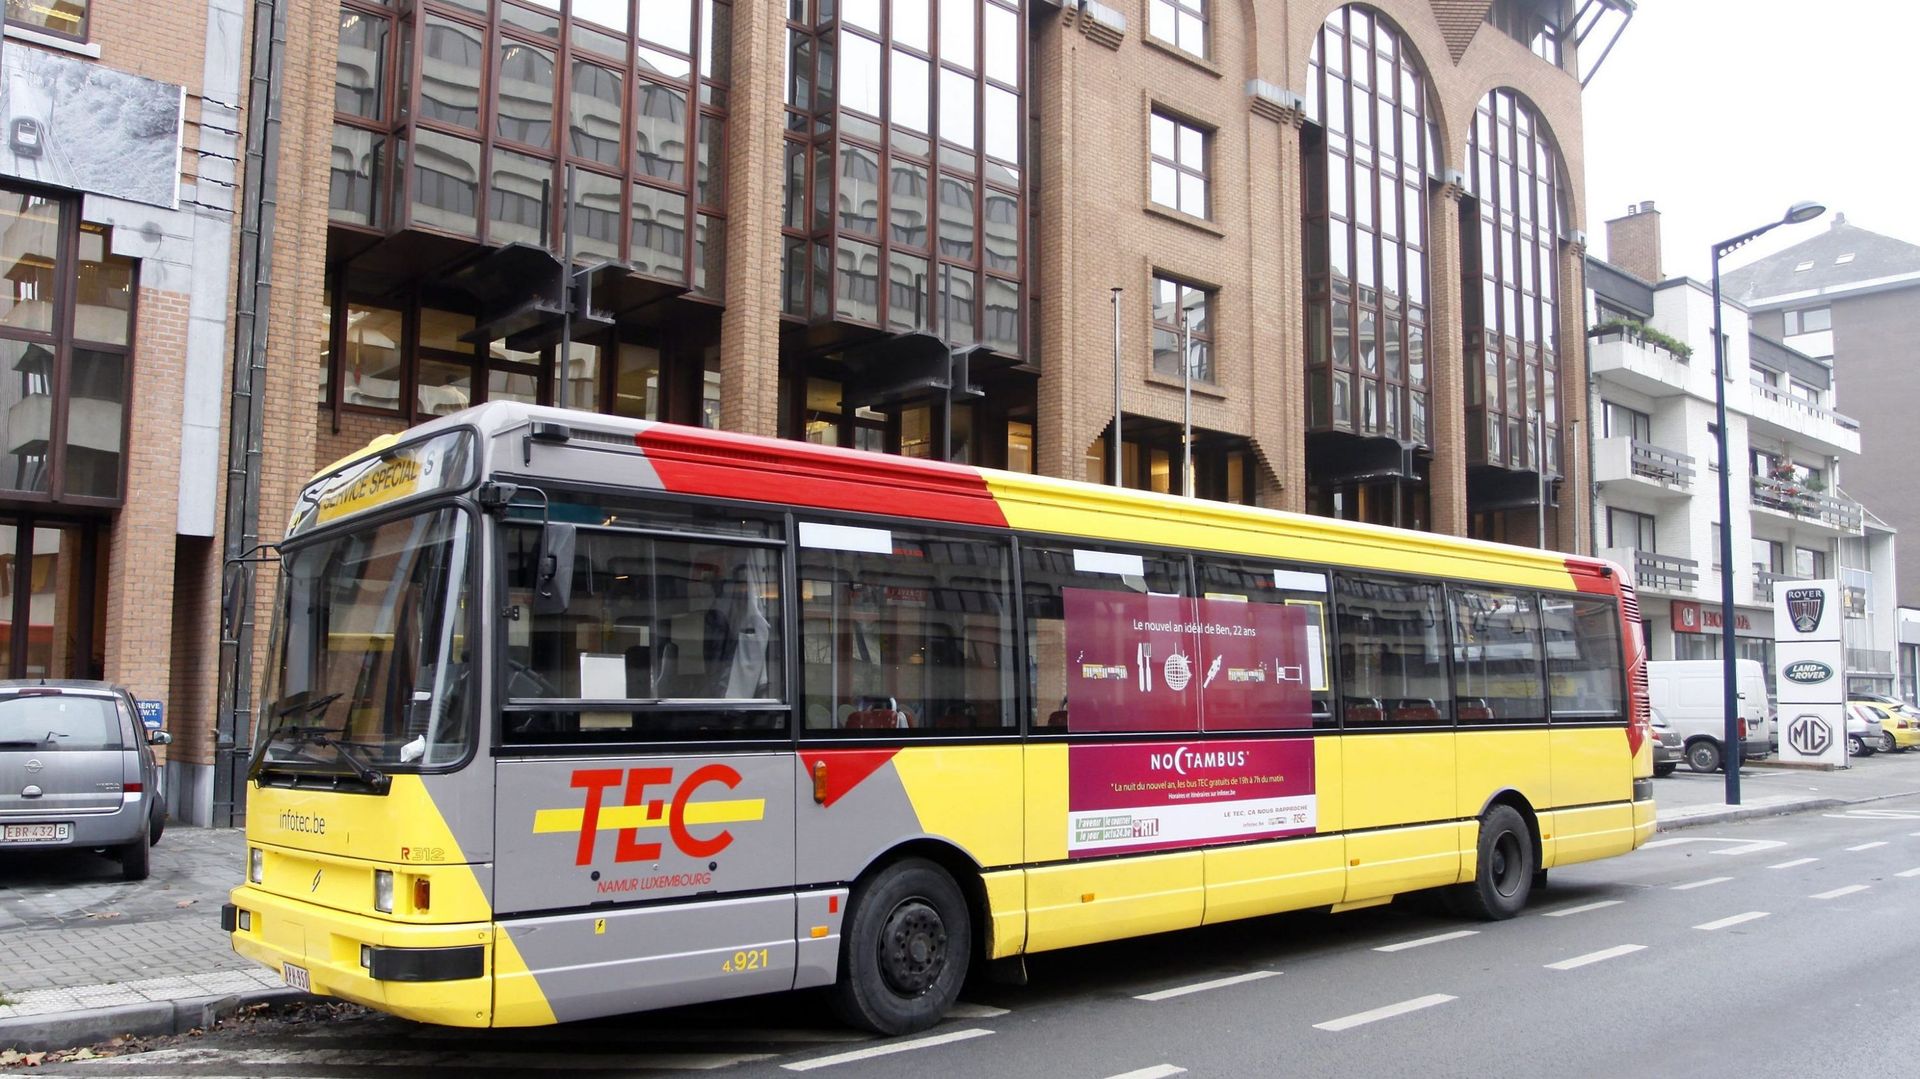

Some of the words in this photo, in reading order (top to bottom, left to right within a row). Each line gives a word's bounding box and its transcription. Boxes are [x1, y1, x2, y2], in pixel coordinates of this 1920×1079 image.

[369, 459, 417, 495] SPECIAL
[1133, 619, 1143, 630] Le
[1145, 621, 1172, 631] nouvel
[1173, 624, 1183, 632] an
[1185, 622, 1203, 633] idéal
[1204, 623, 1214, 634] de
[1216, 624, 1232, 636] Ben,
[1233, 625, 1242, 635] 22
[1243, 628, 1256, 636] ans
[1703, 611, 1751, 630] HODA
[1793, 720, 1826, 750] MG
[1123, 783, 1136, 791] nuit
[1137, 782, 1145, 790] du
[1146, 781, 1167, 790] nouvel
[1177, 780, 1186, 788] les
[1186, 780, 1197, 788] bus
[1197, 779, 1208, 787] TEC
[1208, 777, 1230, 788] gratuits
[1231, 777, 1238, 785] de
[1239, 776, 1249, 784] 19h
[1253, 776, 1260, 784] 7h
[1261, 775, 1268, 783] du
[1269, 775, 1284, 783] matin
[570, 764, 743, 866] TEC
[1257, 807, 1274, 815] NOUS
[59, 827, 65, 835] B
[280, 809, 325, 835] infotec.be
[597, 879, 638, 893] NAMUR
[641, 873, 711, 890] LUXEMBOURG
[722, 949, 768, 973] 4.921
